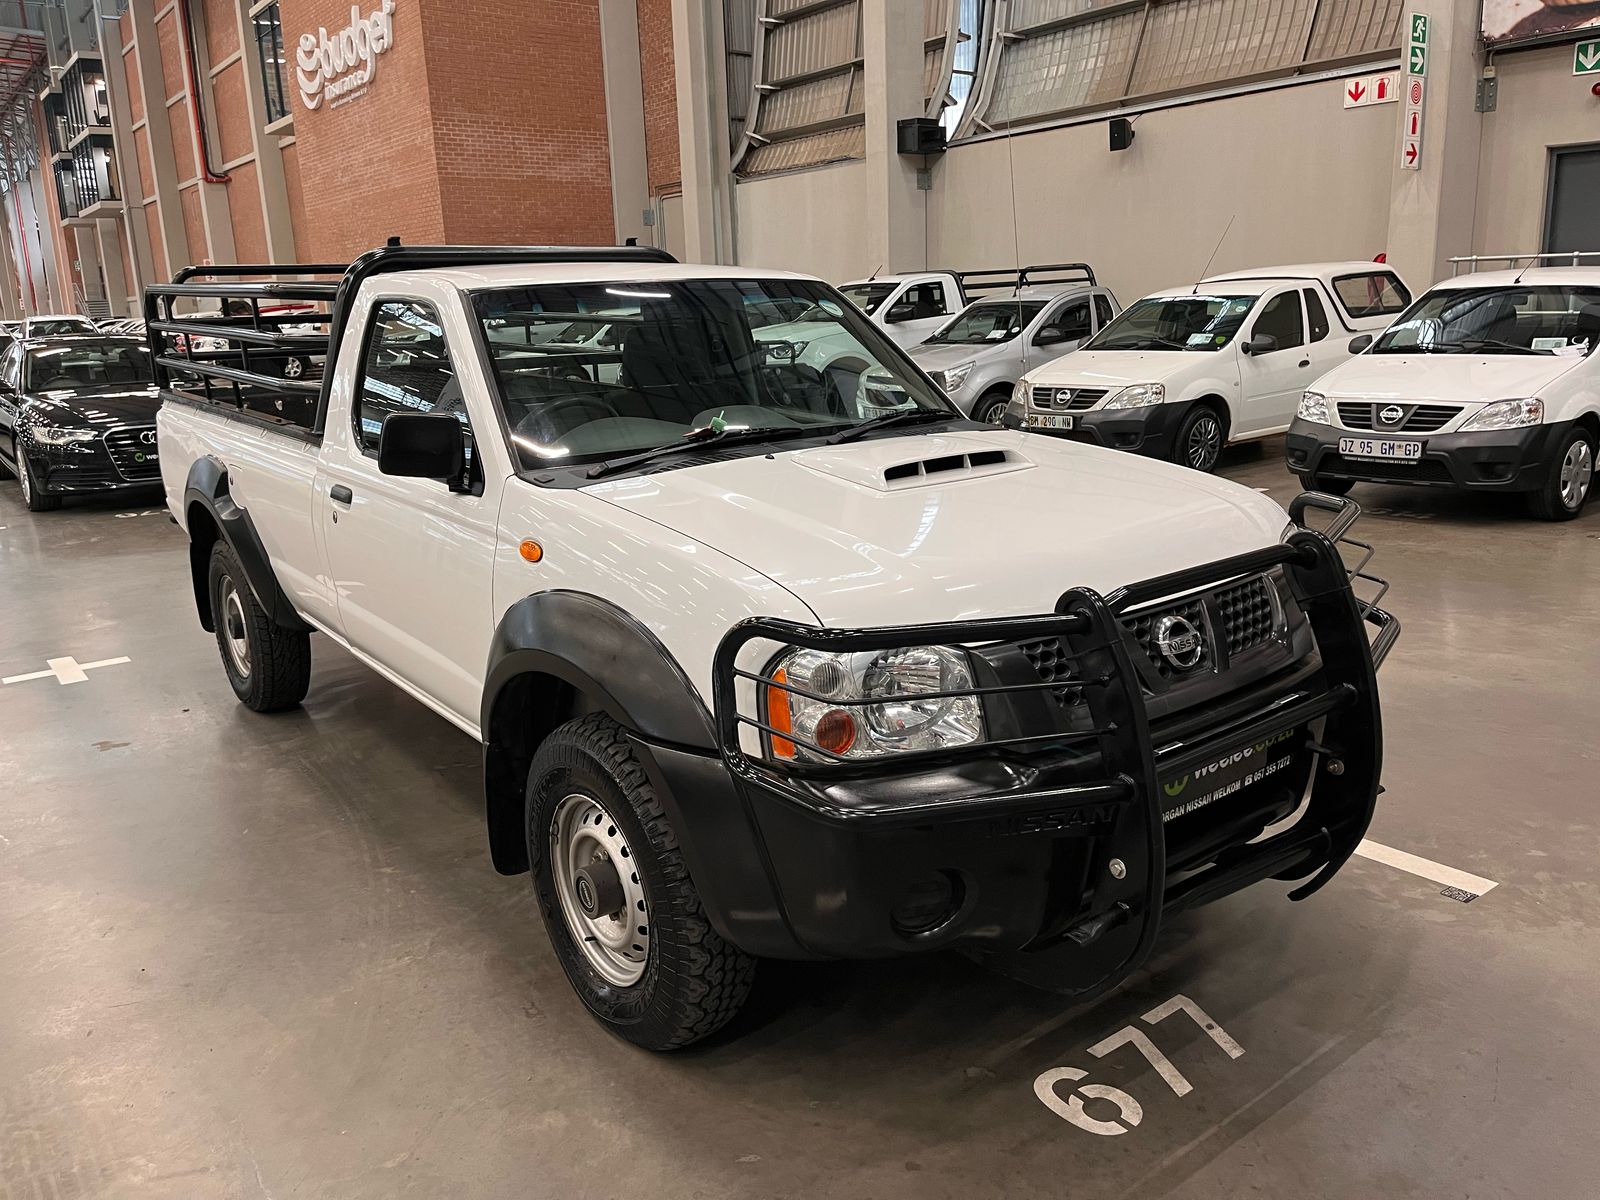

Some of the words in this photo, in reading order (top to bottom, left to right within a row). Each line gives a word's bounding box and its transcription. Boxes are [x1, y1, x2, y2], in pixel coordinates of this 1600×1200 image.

[319, 0, 396, 83] budget
[1341, 439, 1355, 453] JZ
[1360, 441, 1373, 454] 95
[1380, 442, 1396, 456] GM
[1404, 443, 1420, 457] GP
[1186, 792, 1213, 813] NISSAN
[1213, 780, 1241, 801] WELKOM
[1033, 993, 1246, 1136] 677
